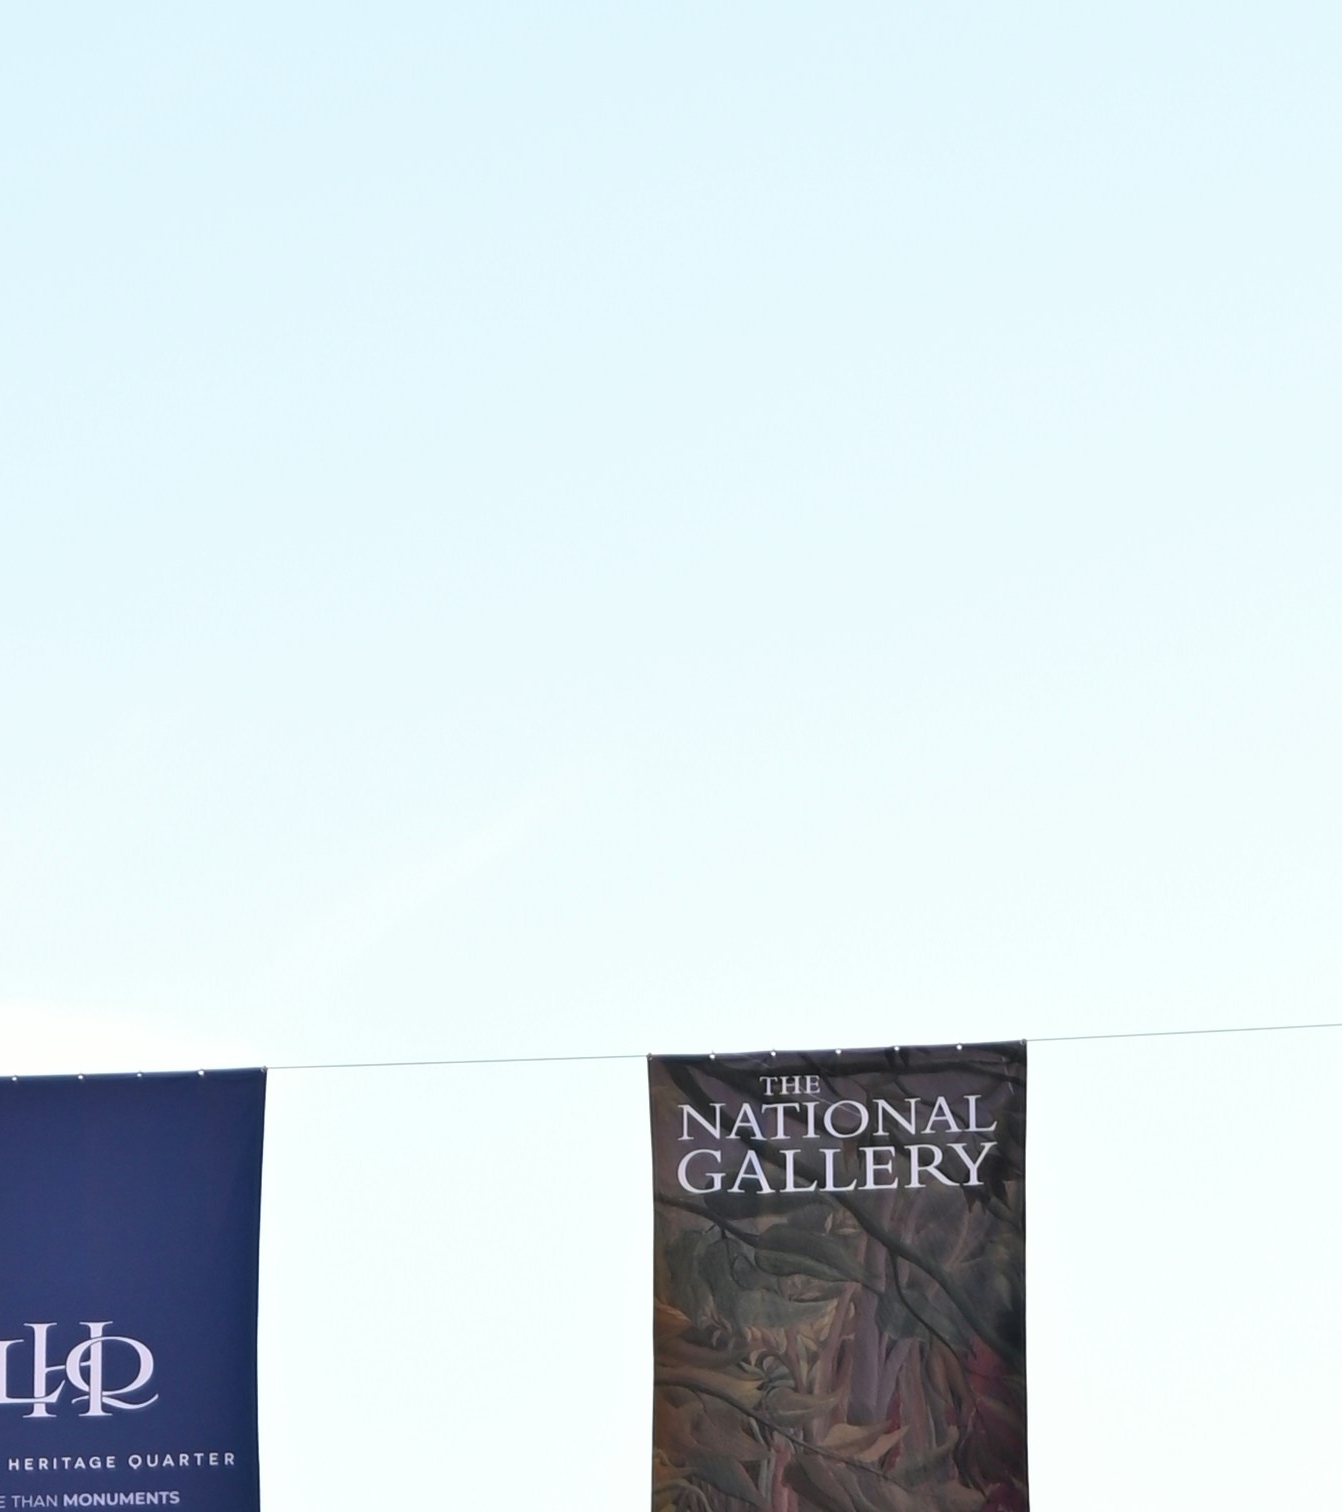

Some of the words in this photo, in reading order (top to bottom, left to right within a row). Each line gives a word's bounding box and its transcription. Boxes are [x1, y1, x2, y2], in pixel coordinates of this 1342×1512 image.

[759, 1075, 821, 1096] THE
[678, 1094, 997, 1141] NATIONAL
[678, 1142, 997, 1195] GALLERY
[8, 1455, 117, 1471] HERITAGE
[128, 1452, 236, 1469] QUARTER
[10, 1494, 58, 1509] THAN
[63, 1491, 180, 1507] MONUMENTS
